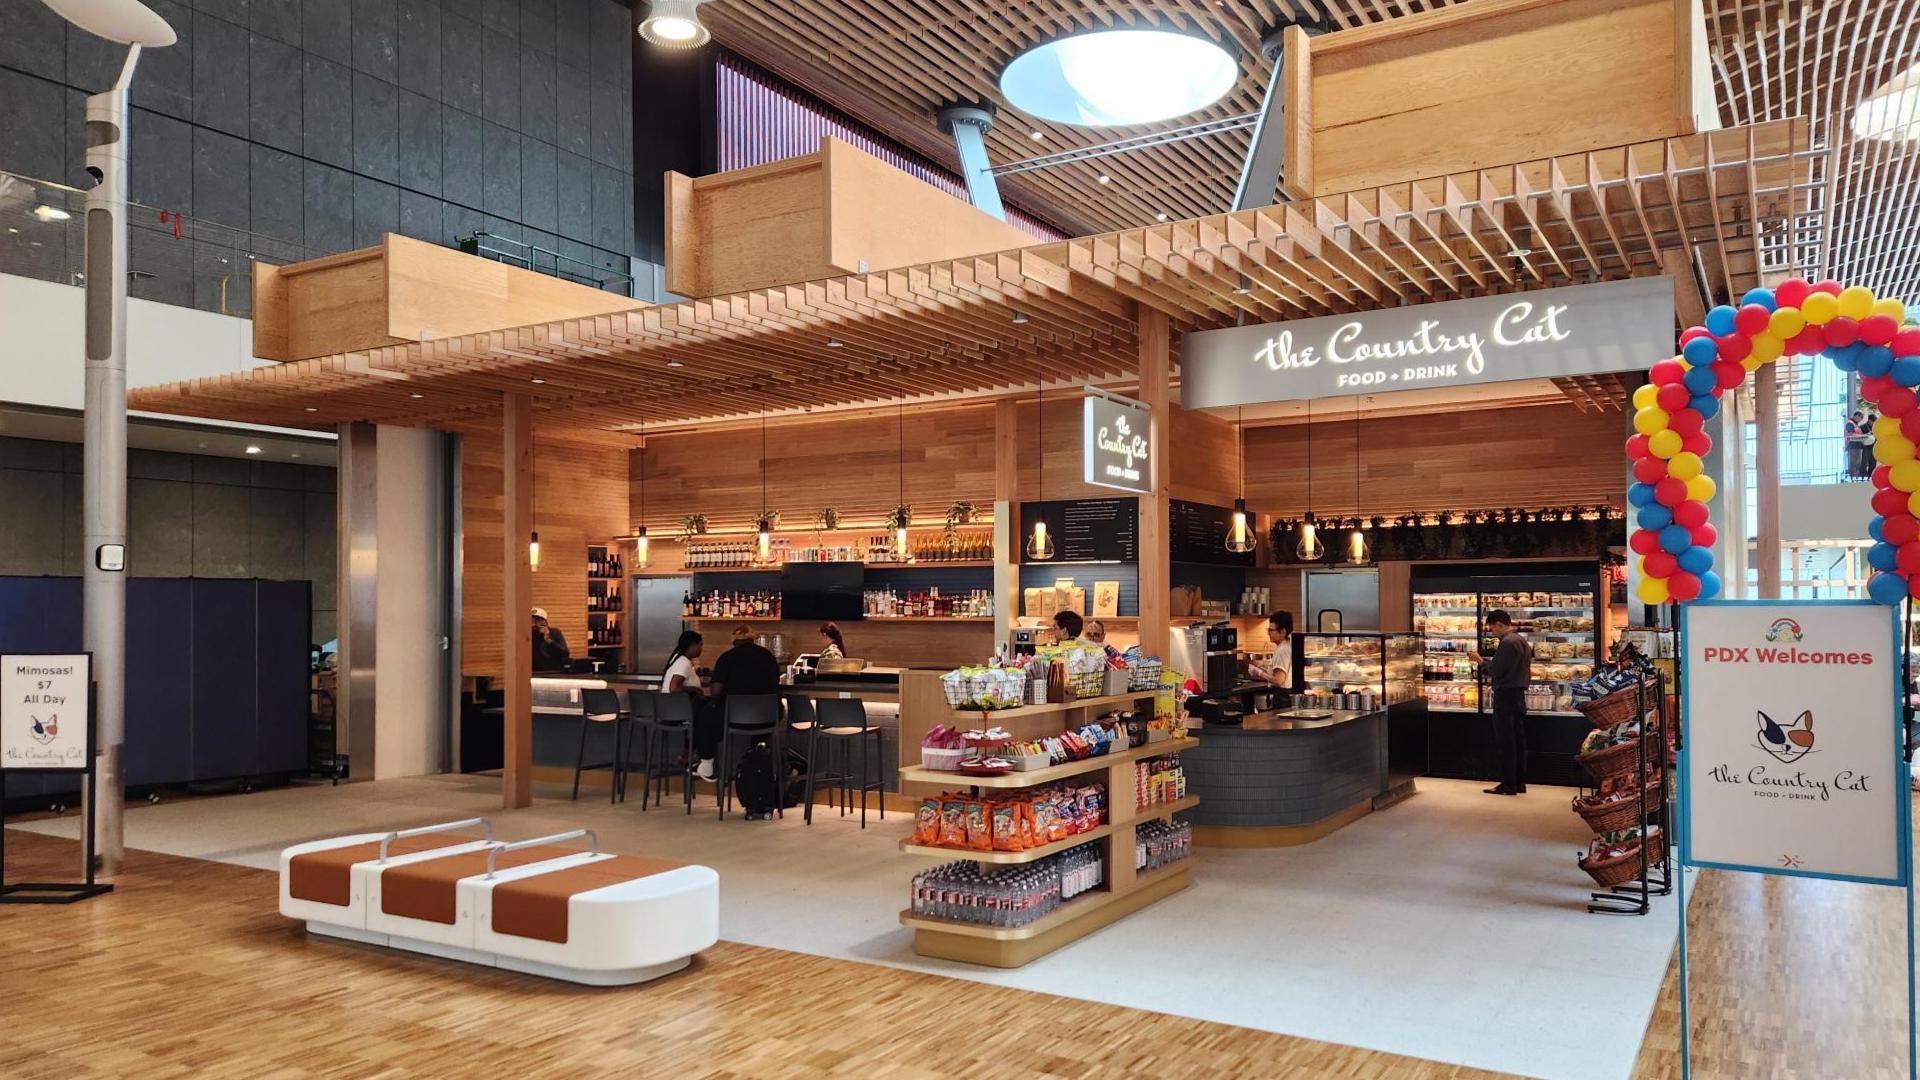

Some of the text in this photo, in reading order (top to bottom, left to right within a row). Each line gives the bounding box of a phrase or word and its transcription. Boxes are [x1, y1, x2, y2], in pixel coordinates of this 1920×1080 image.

[1254, 301, 1571, 375] the Country Cat
[1338, 363, 1458, 388] FOOD DRINK
[1116, 415, 1131, 435] the
[1098, 426, 1148, 468] Country Cat
[1704, 647, 1873, 665] PDX Welcomes
[16, 665, 73, 675] Mimosas!
[37, 680, 52, 689] $7
[24, 694, 66, 705] All Day
[1708, 763, 1873, 801] the Country Cat
[1754, 790, 1816, 801] FOOD DRINK
